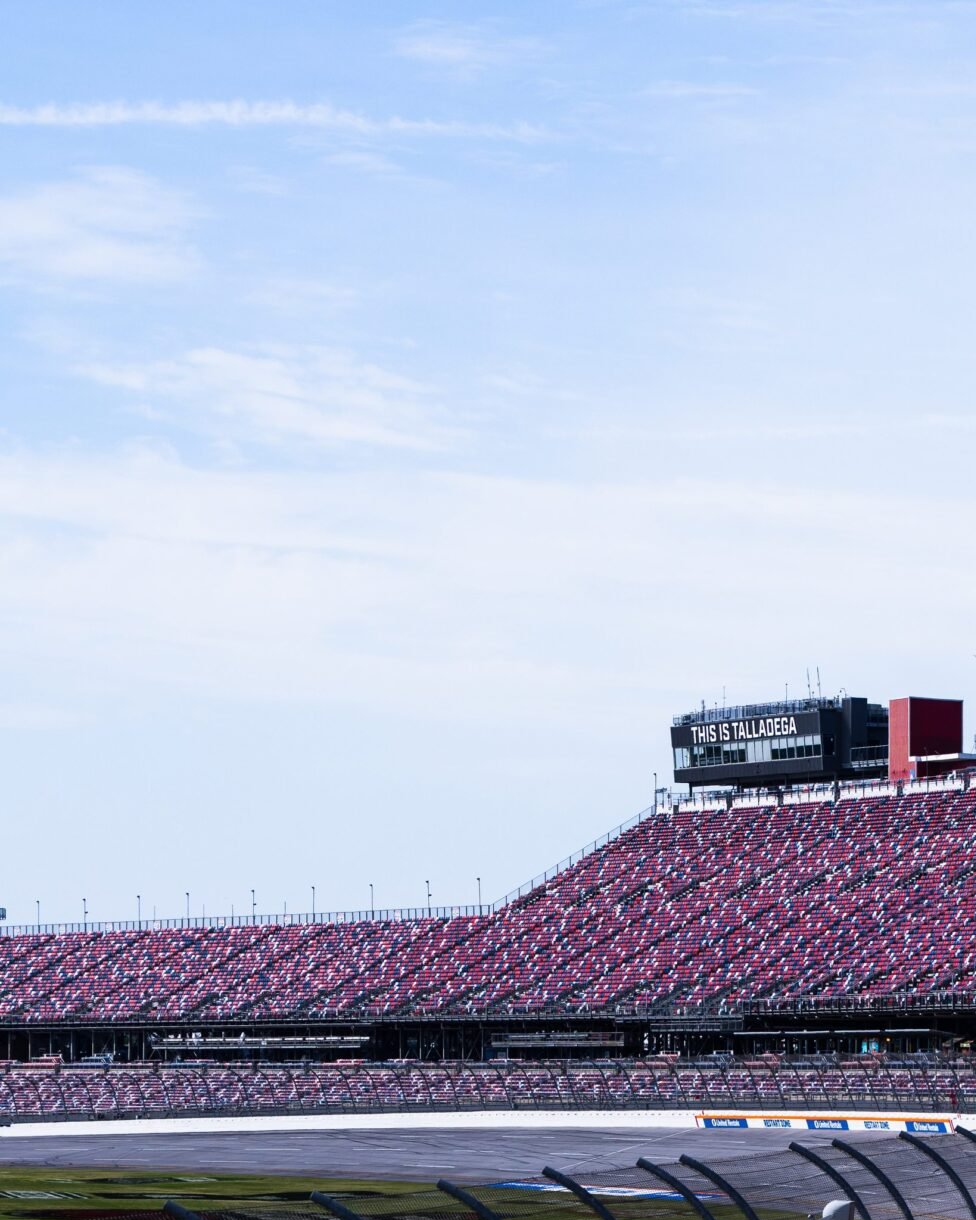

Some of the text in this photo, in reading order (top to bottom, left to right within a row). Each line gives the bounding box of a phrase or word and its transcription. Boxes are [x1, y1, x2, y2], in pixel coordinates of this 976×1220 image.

[690, 716, 797, 744] THIS IS TALLADEGA
